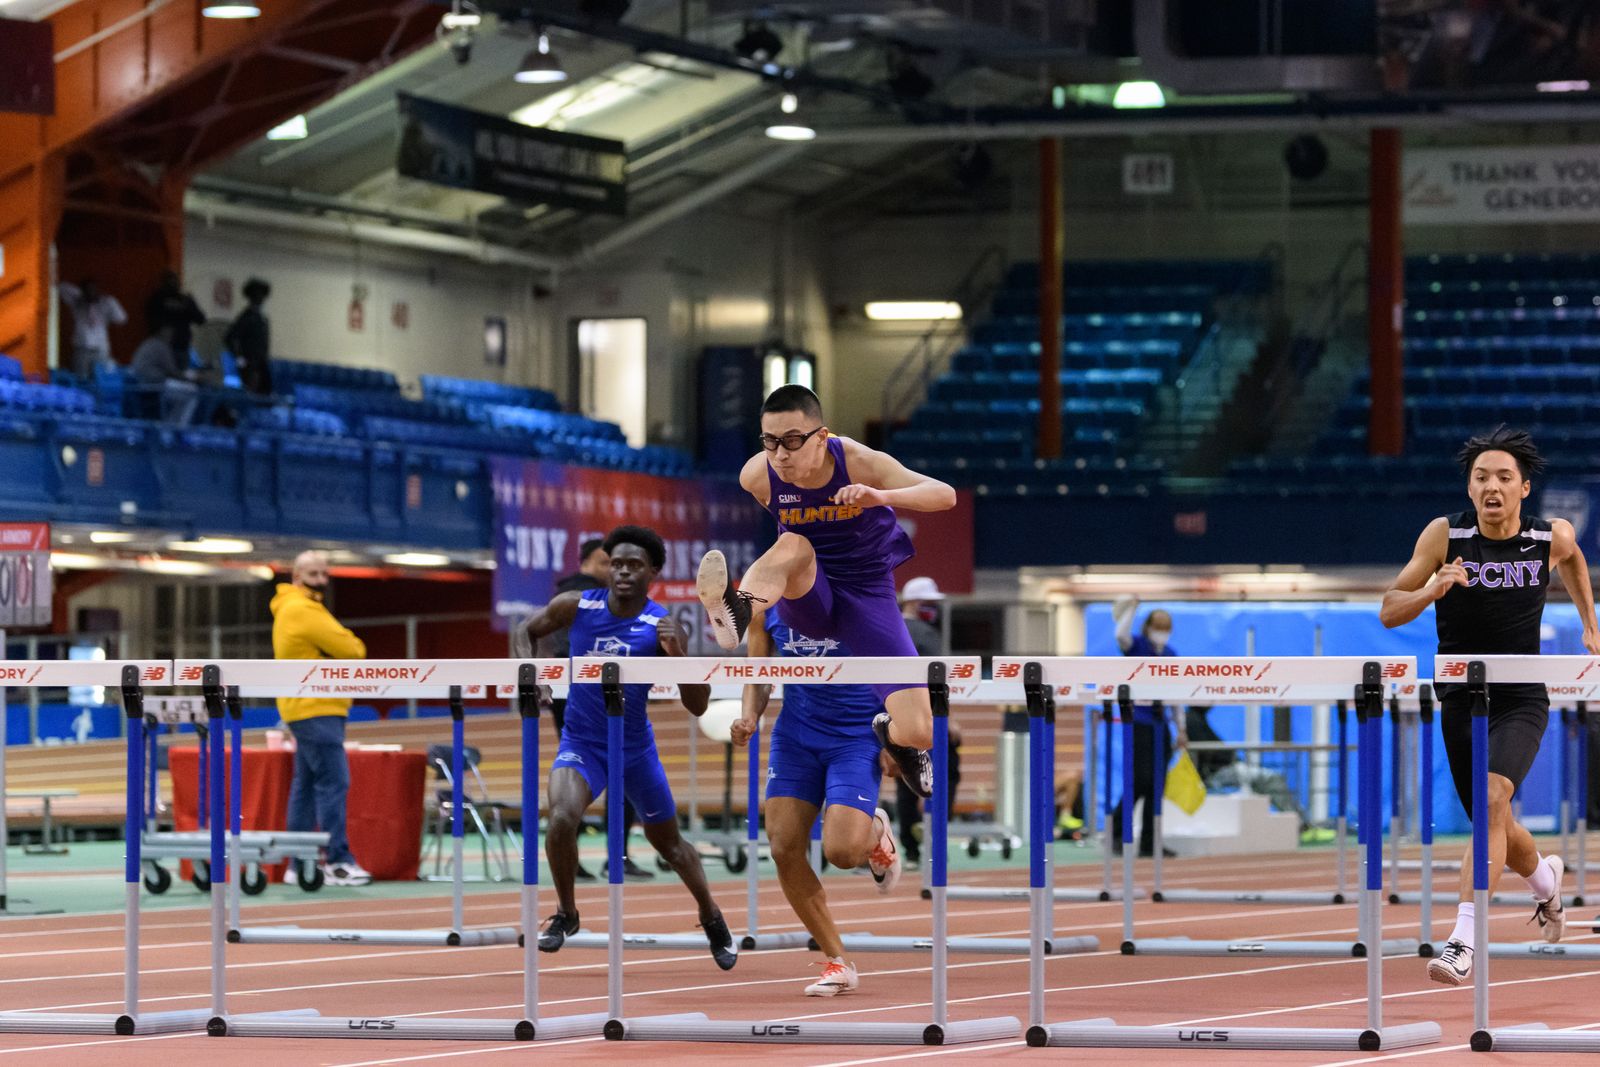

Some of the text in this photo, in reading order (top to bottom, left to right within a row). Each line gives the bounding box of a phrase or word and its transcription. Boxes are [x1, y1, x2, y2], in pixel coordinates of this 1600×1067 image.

[1450, 162, 1537, 182] THANK
[778, 494, 801, 502] CUNY
[779, 505, 863, 525] HUNTER
[1459, 560, 1542, 588] CCNY
[321, 667, 419, 679] THE ARMORY
[724, 666, 826, 678] THE ARMORY
[1148, 665, 1254, 677] THE ARMORY
[311, 685, 379, 693] THE ARMORY
[1204, 686, 1278, 695] THE ARMORY
[1529, 945, 1566, 955] UCS
[348, 1020, 395, 1030] UCS
[752, 1025, 800, 1036] UCS
[1179, 1031, 1229, 1042] UCS
